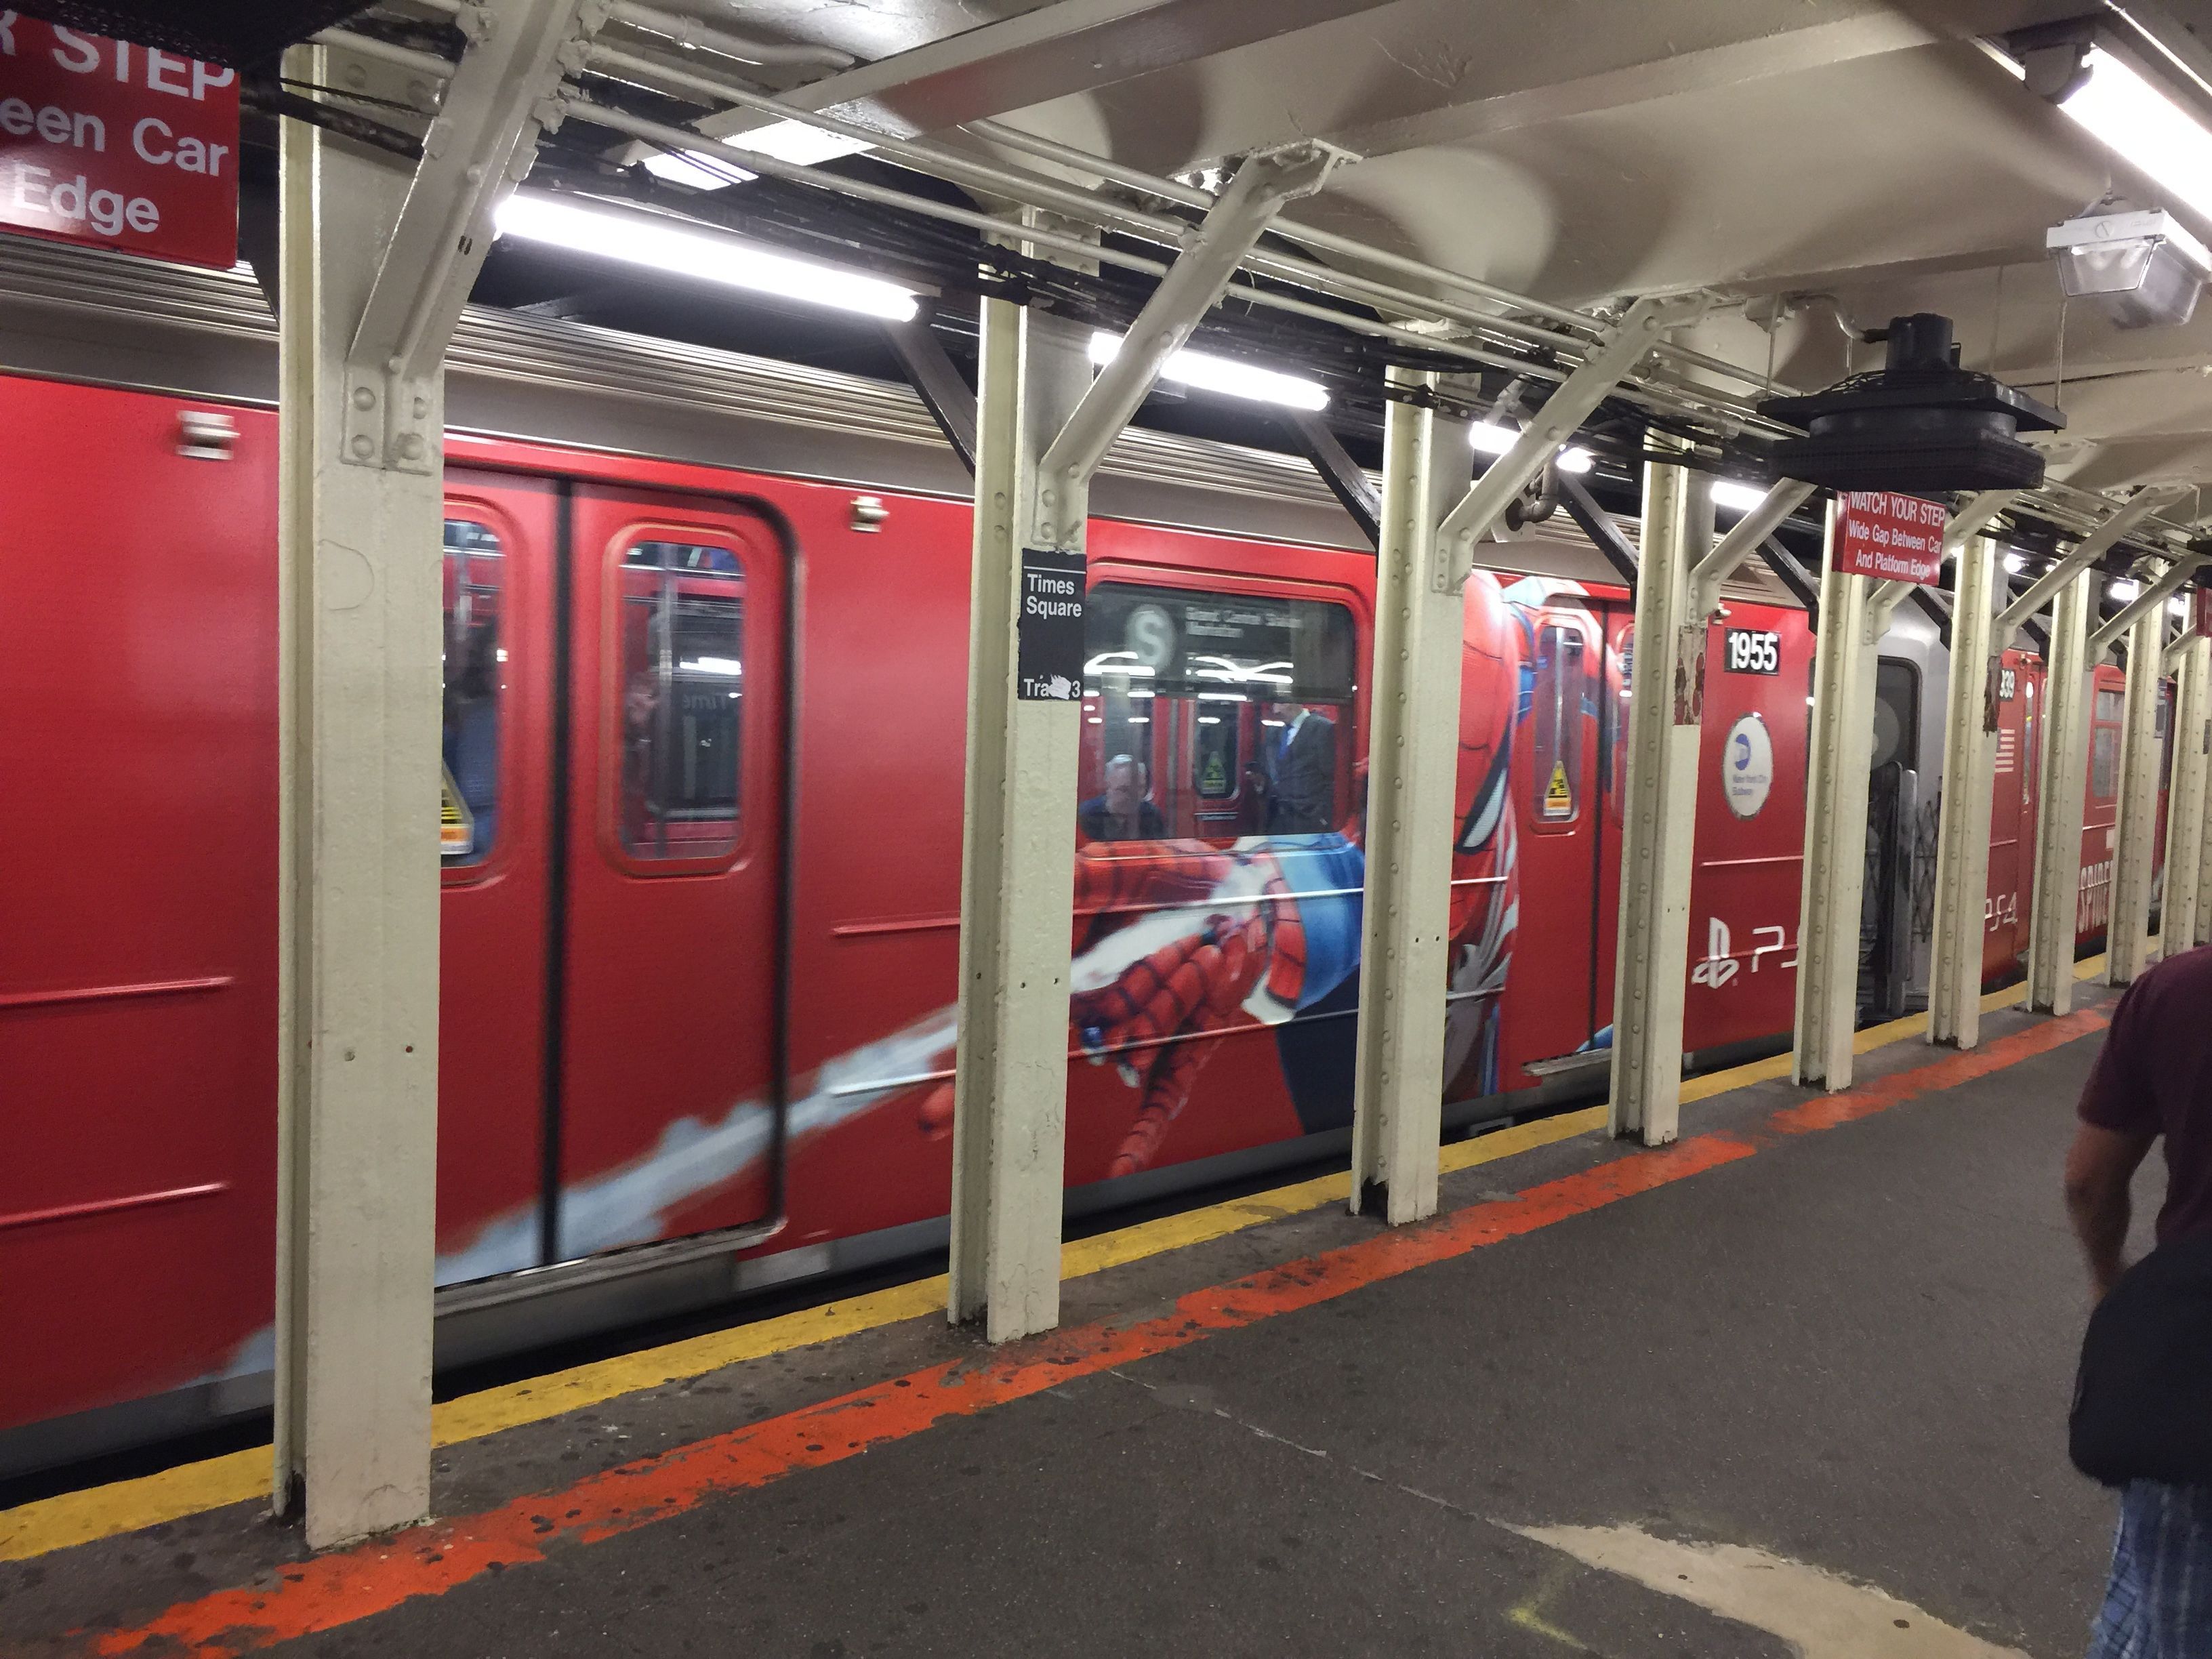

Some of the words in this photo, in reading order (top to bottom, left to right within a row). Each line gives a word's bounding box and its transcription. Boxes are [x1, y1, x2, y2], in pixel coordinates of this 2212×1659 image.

[133, 117, 229, 177] Car
[14, 159, 160, 237] Edge
[1849, 491, 1887, 515] WATCH
[1891, 495, 1917, 522] YOUR
[1920, 503, 1946, 527] STEP
[1849, 519, 1870, 541] Wide
[1872, 524, 1890, 548] Gap
[1891, 528, 1925, 551] Between
[1927, 535, 1942, 554] Car
[1856, 549, 1873, 569] And
[1875, 552, 1908, 574] Platform
[1910, 558, 1931, 580] Edge
[1027, 573, 1075, 595] Times
[1026, 595, 1082, 619] Square
[1134, 613, 1164, 665] S
[1728, 632, 1778, 671] 1955
[1023, 678, 1069, 698] Tra
[1071, 680, 1081, 698] 3
